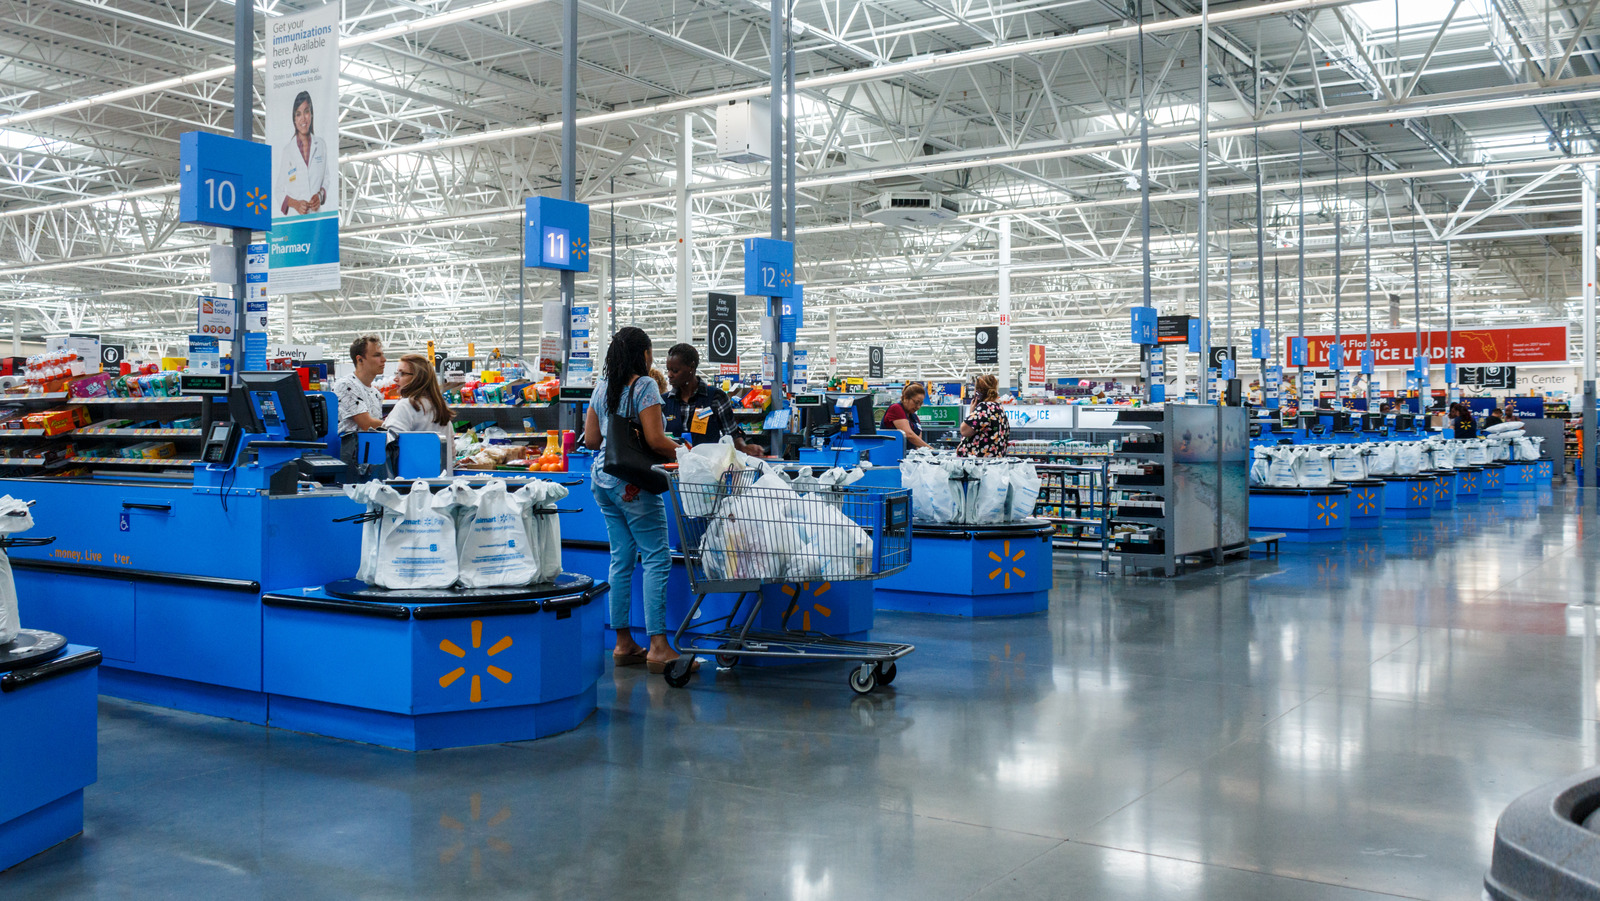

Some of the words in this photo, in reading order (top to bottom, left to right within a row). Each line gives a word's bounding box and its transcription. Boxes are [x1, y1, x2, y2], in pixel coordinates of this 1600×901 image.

[273, 23, 286, 33] Get
[288, 20, 304, 33] your
[273, 25, 332, 45] immunizations
[273, 47, 291, 57] here.
[292, 37, 326, 53] Available
[273, 58, 293, 69] every
[294, 54, 309, 65] day.
[204, 178, 236, 212] 10
[271, 243, 311, 254] Pharmacy
[548, 232, 564, 258] 11
[762, 267, 776, 288] 12
[1143, 325, 1149, 338] 14
[1320, 340, 1346, 348] Votd
[1349, 339, 1388, 347] Florda's
[276, 348, 307, 360] Jewelry
[1319, 350, 1352, 362] LW
[1356, 348, 1399, 361] PICE
[1532, 375, 1566, 384] Center
[1037, 410, 1049, 419] ICE
[55, 549, 83, 562] money.
[86, 550, 102, 562] Live
